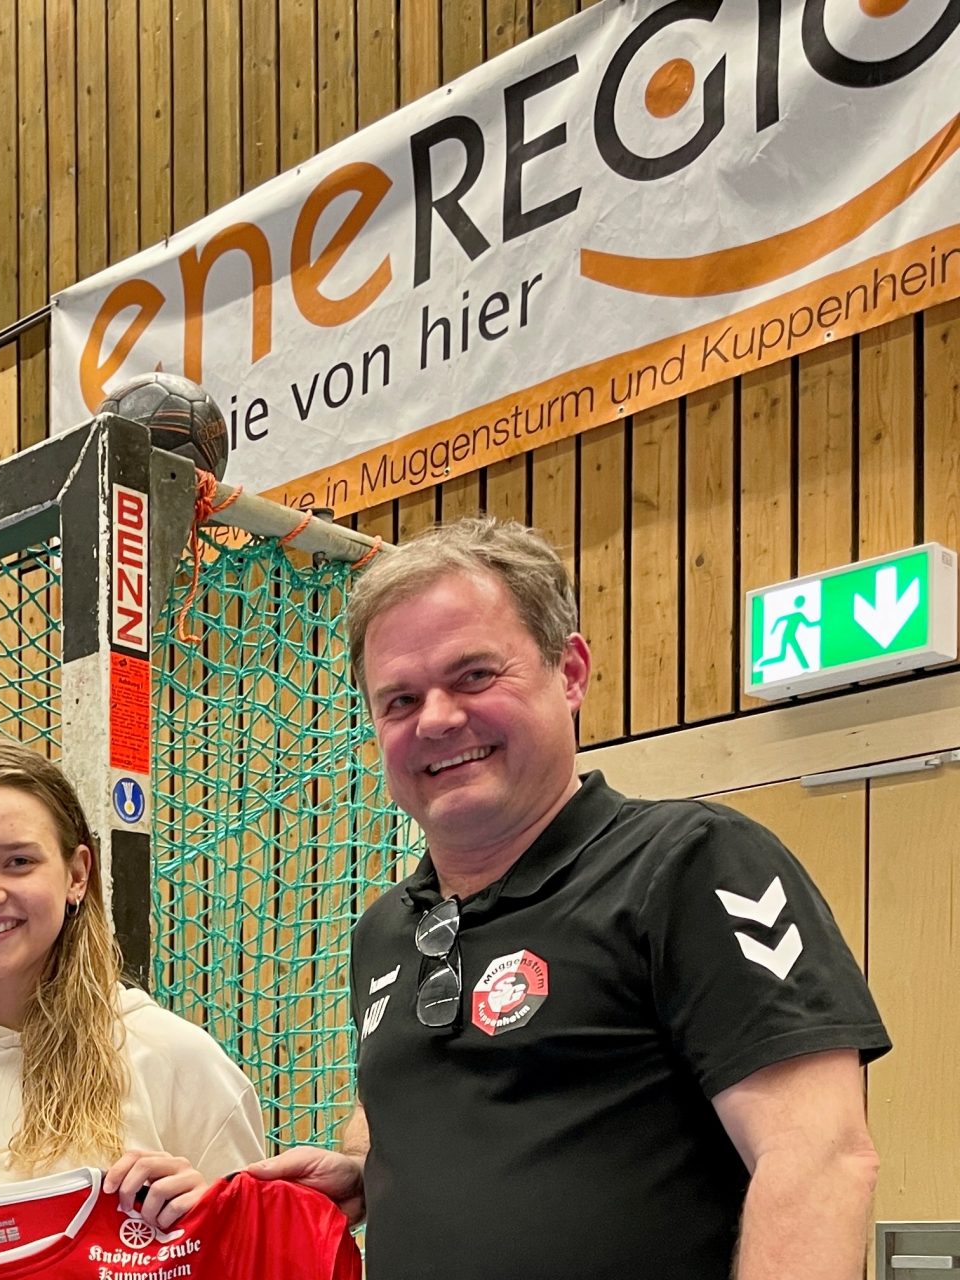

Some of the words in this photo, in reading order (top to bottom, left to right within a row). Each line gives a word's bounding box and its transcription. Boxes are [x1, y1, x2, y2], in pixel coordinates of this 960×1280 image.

[290, 343, 390, 421] von
[418, 272, 542, 369] hier
[326, 477, 347, 507] in
[359, 386, 594, 496] Muggensturm
[610, 344, 686, 405] und
[116, 491, 144, 647] BENZ
[478, 1001, 531, 1028] Kuppenheim
[483, 957, 545, 990] Muggensturm
[88, 1238, 201, 1268] Knöpfle-Stube
